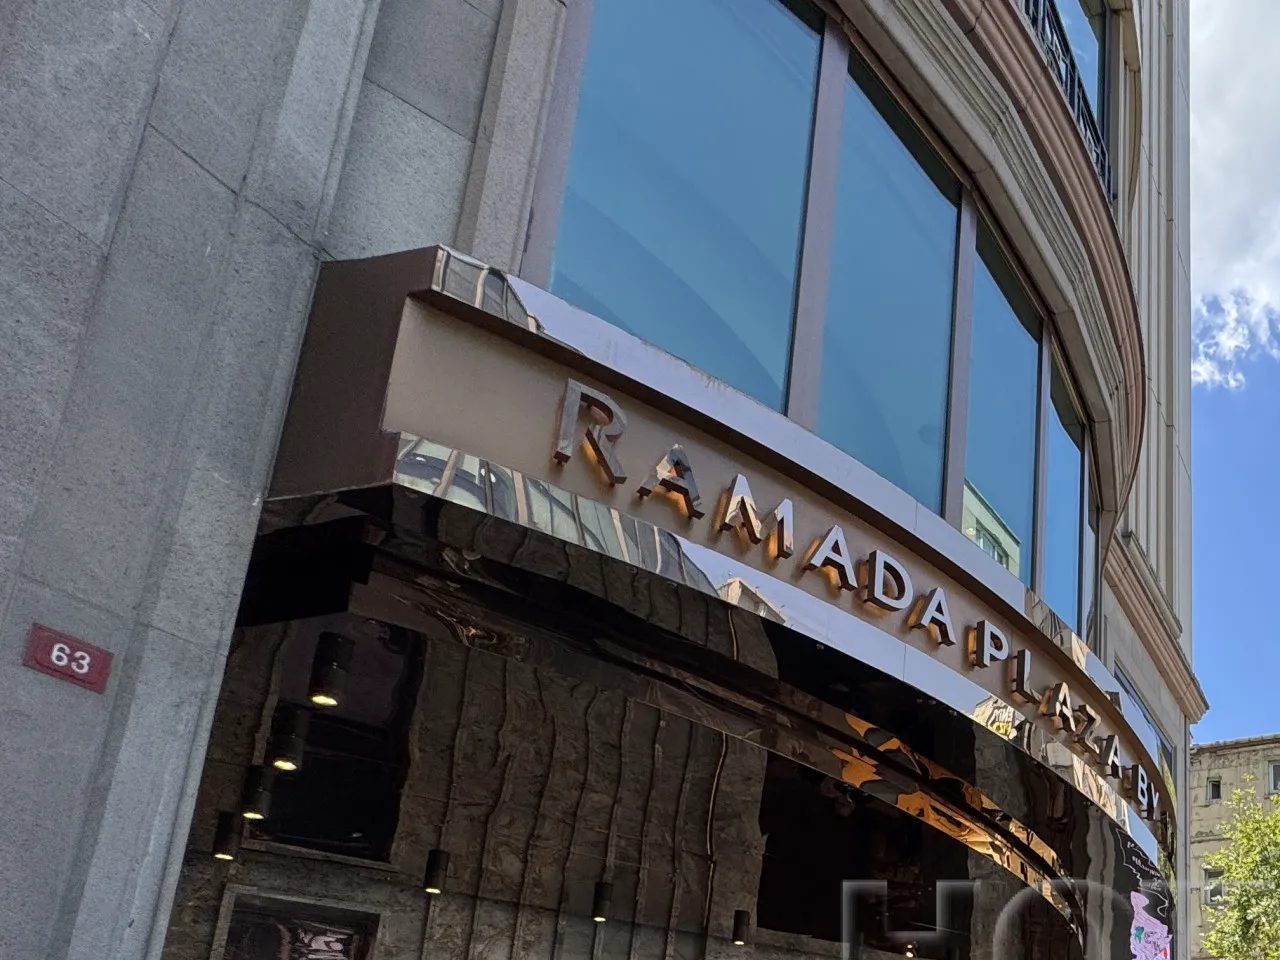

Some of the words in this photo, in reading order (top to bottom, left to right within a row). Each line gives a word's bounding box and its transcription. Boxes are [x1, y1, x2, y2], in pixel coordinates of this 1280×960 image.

[51, 643, 91, 674] 63
[554, 378, 956, 646] RAMADA
[975, 620, 1122, 779] PLAZA
[1131, 764, 1160, 821] BY
